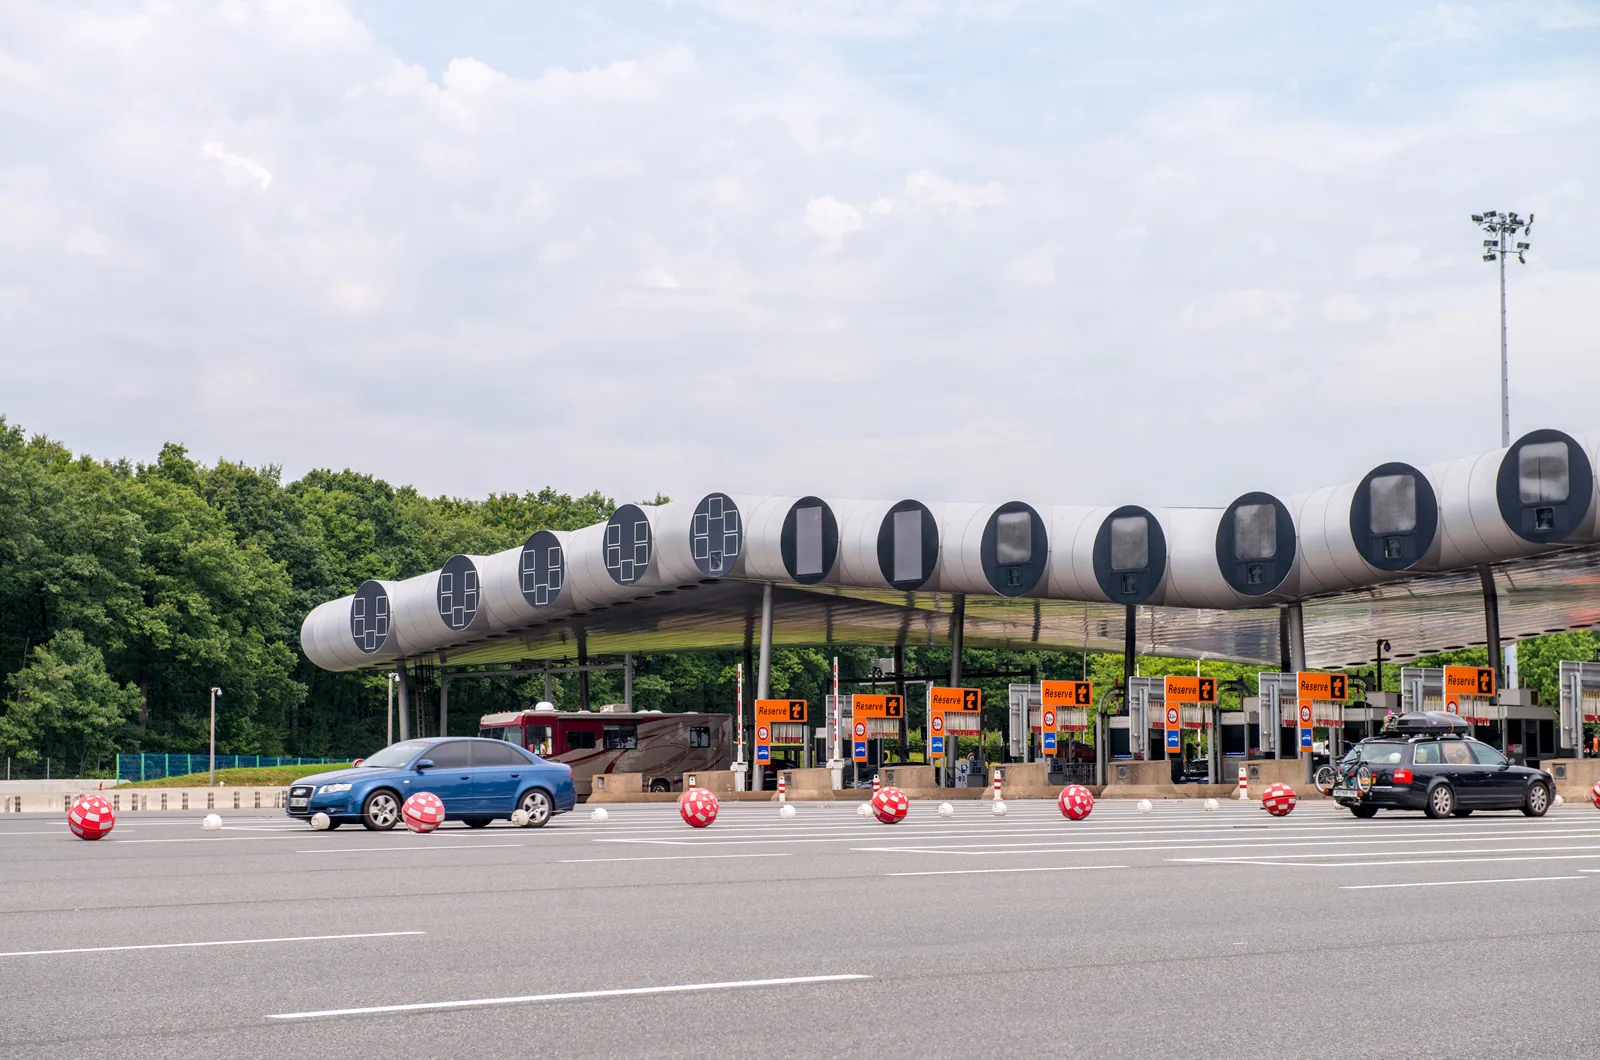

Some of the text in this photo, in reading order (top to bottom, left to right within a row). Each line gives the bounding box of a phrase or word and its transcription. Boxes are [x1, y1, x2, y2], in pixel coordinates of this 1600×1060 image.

[1448, 674, 1475, 686] Réservé
[1168, 684, 1196, 694] Réservé
[1301, 680, 1328, 691] Réservé
[1045, 689, 1072, 698] Réservé
[933, 695, 961, 704] Réservé
[759, 706, 787, 715] Réservé
[856, 701, 883, 711] Réservé
